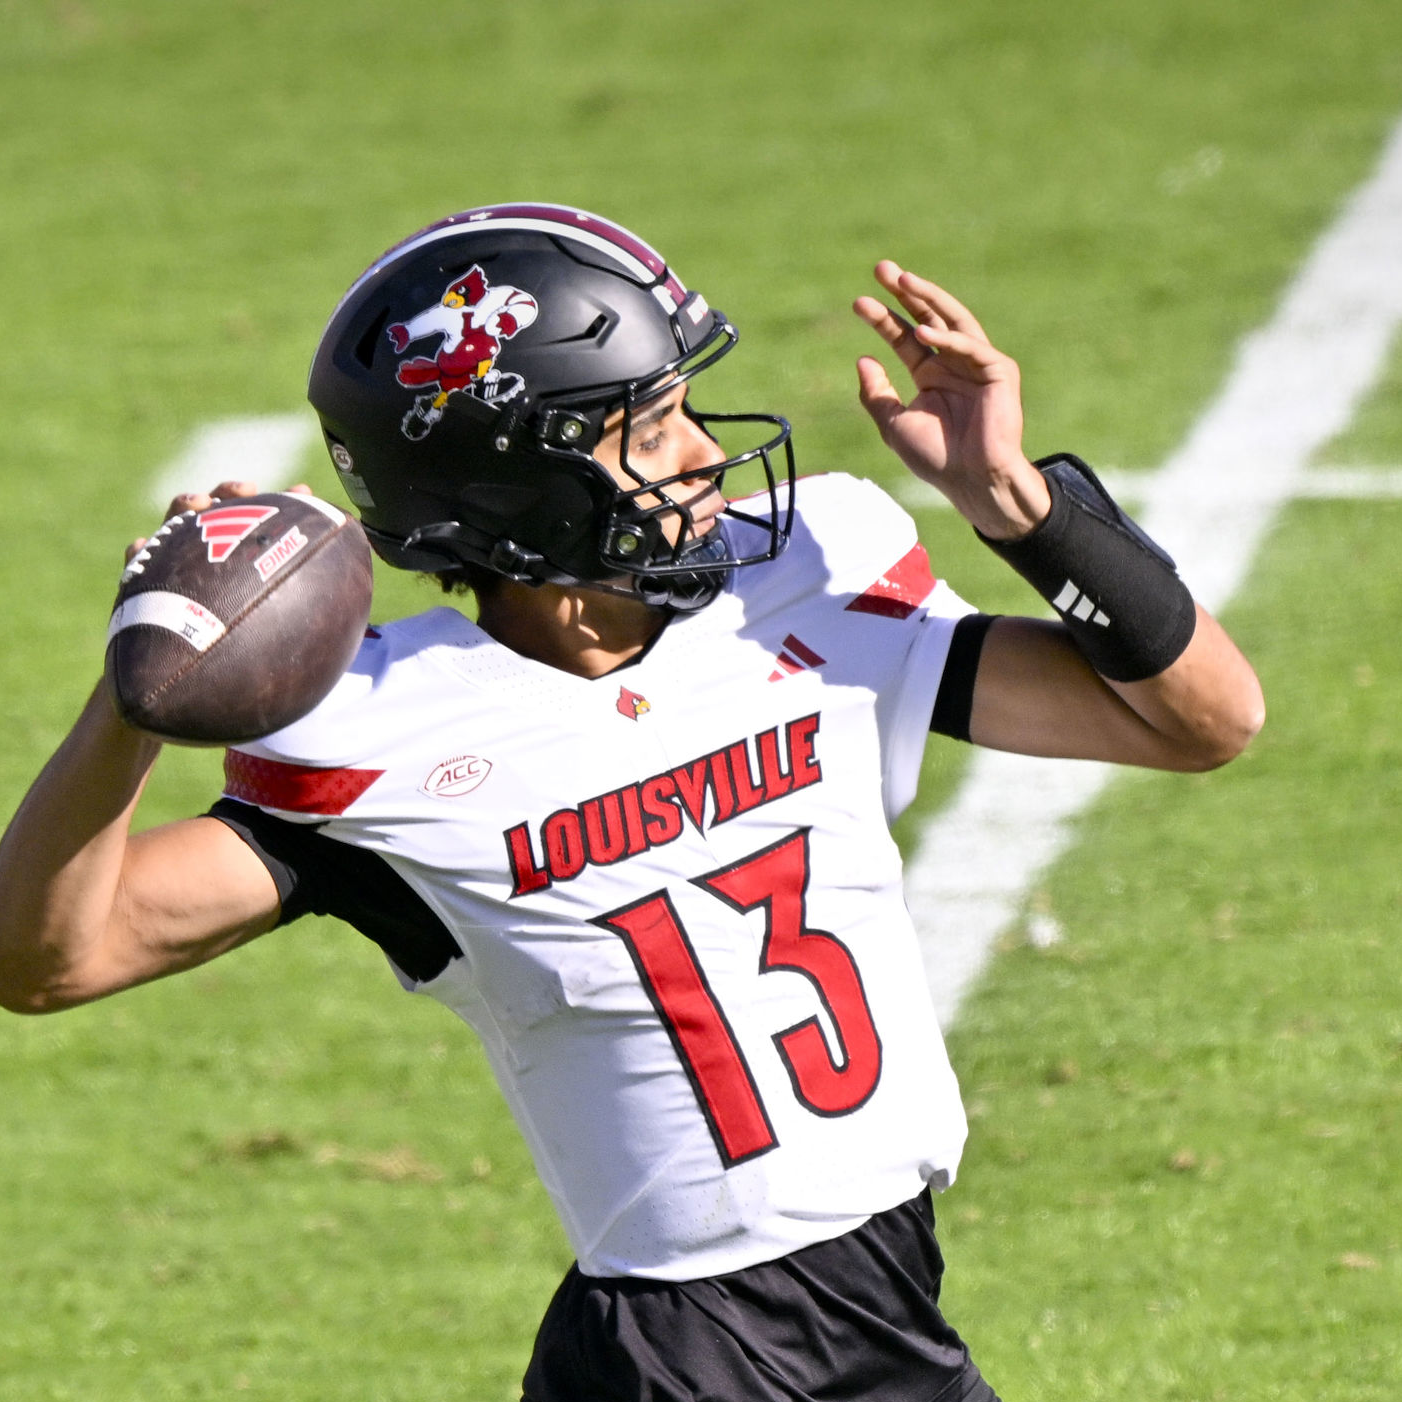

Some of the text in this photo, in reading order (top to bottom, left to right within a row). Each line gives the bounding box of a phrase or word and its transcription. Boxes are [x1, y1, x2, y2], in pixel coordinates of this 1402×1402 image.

[436, 759, 480, 787] ACC
[503, 711, 822, 899] LOUISVILLE
[586, 826, 883, 1170] 13
